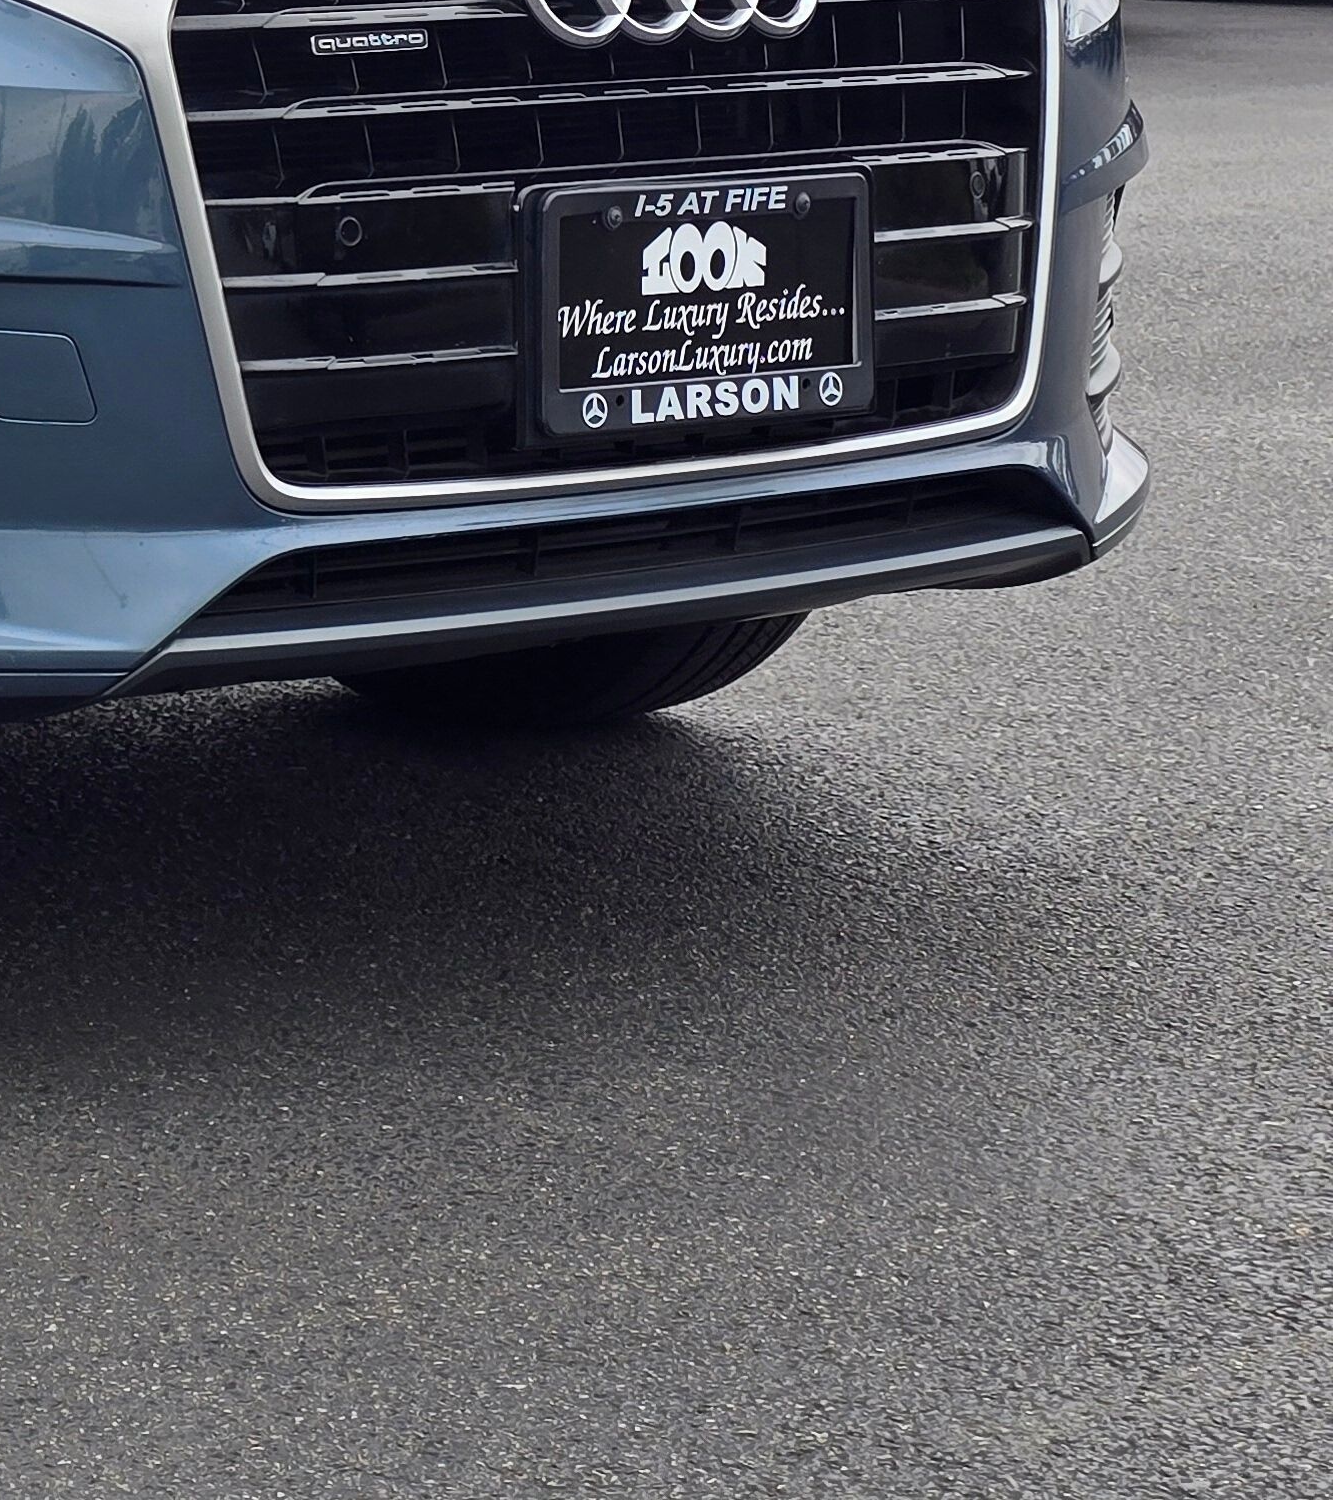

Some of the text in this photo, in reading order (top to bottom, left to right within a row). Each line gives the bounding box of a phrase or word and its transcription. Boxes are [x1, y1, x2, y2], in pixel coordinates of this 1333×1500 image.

[318, 33, 424, 51] quattro
[635, 185, 787, 217] I-5 AT FIFE
[642, 221, 766, 295] LOOK
[558, 284, 845, 339] Where Luxury Resides...
[591, 335, 813, 379] LarsonLuxury.com
[631, 376, 800, 424] LARSON
